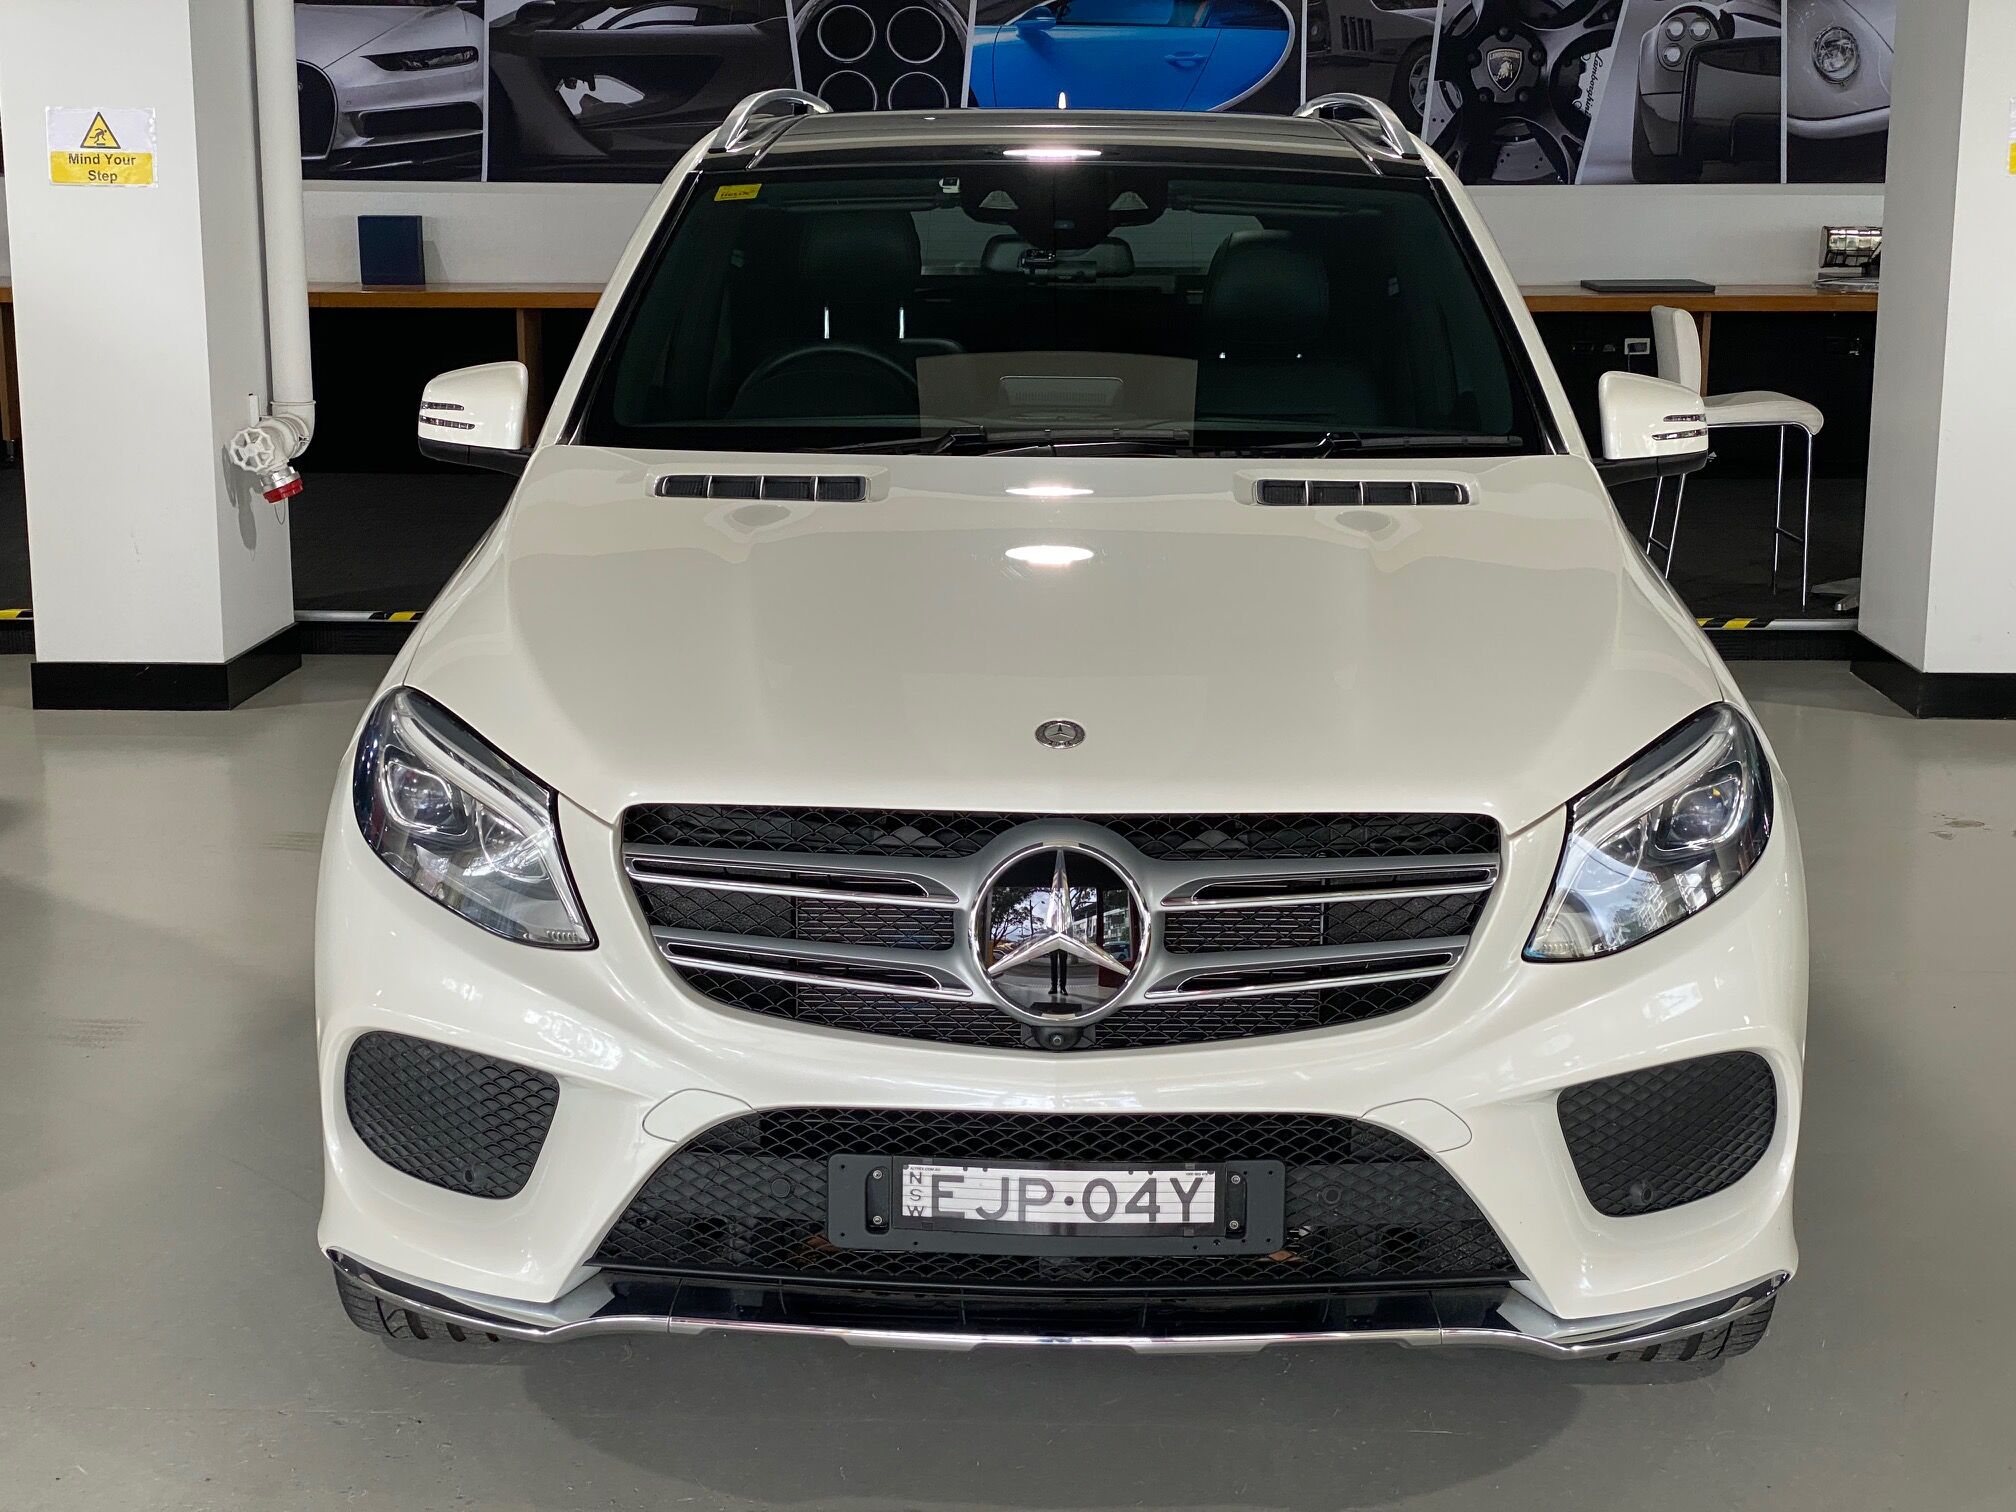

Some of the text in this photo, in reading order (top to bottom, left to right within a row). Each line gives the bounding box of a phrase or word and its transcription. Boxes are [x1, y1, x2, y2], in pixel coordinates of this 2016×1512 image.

[68, 153, 136, 166] Mind Your
[88, 170, 118, 183] Step
